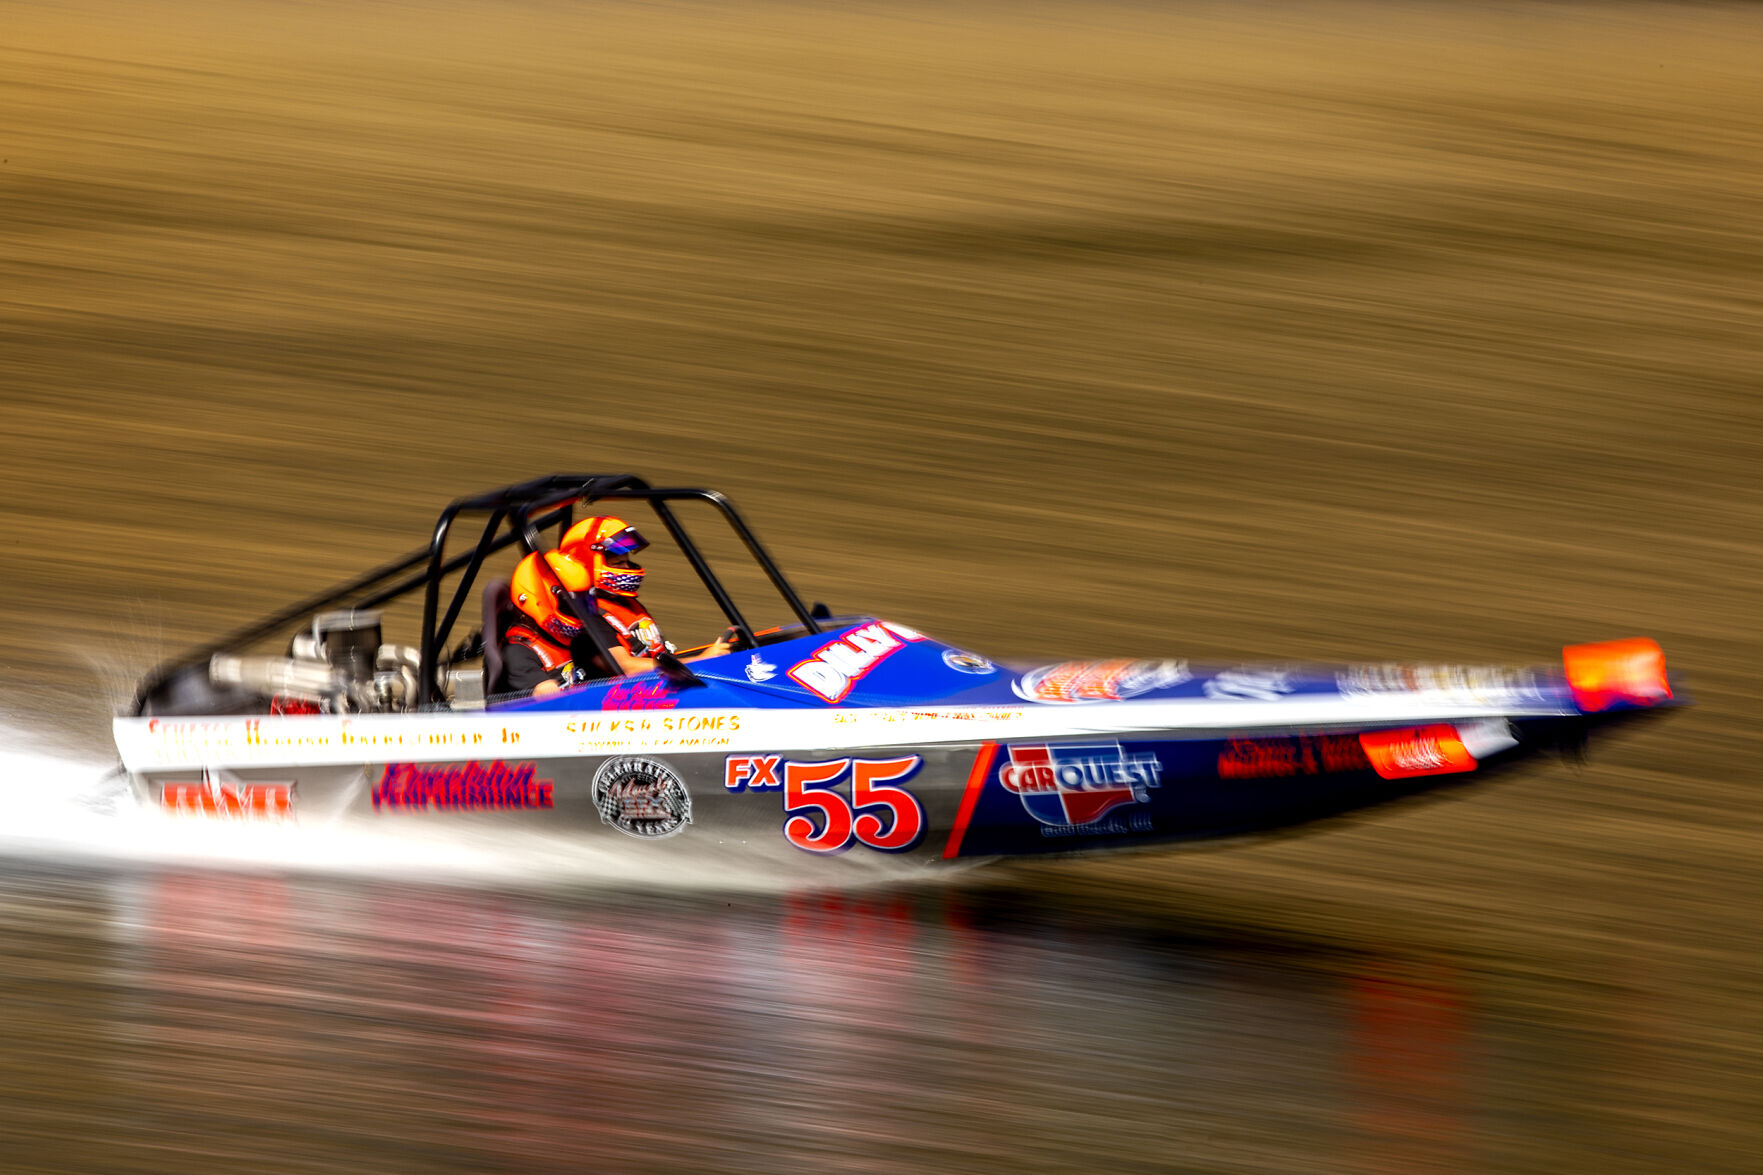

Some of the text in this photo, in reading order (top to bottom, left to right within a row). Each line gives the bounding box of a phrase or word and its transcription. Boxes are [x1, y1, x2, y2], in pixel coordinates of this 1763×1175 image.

[663, 715, 740, 731] STONES
[1000, 755, 1162, 794] CARQUEST
[725, 754, 924, 852] FX 55
